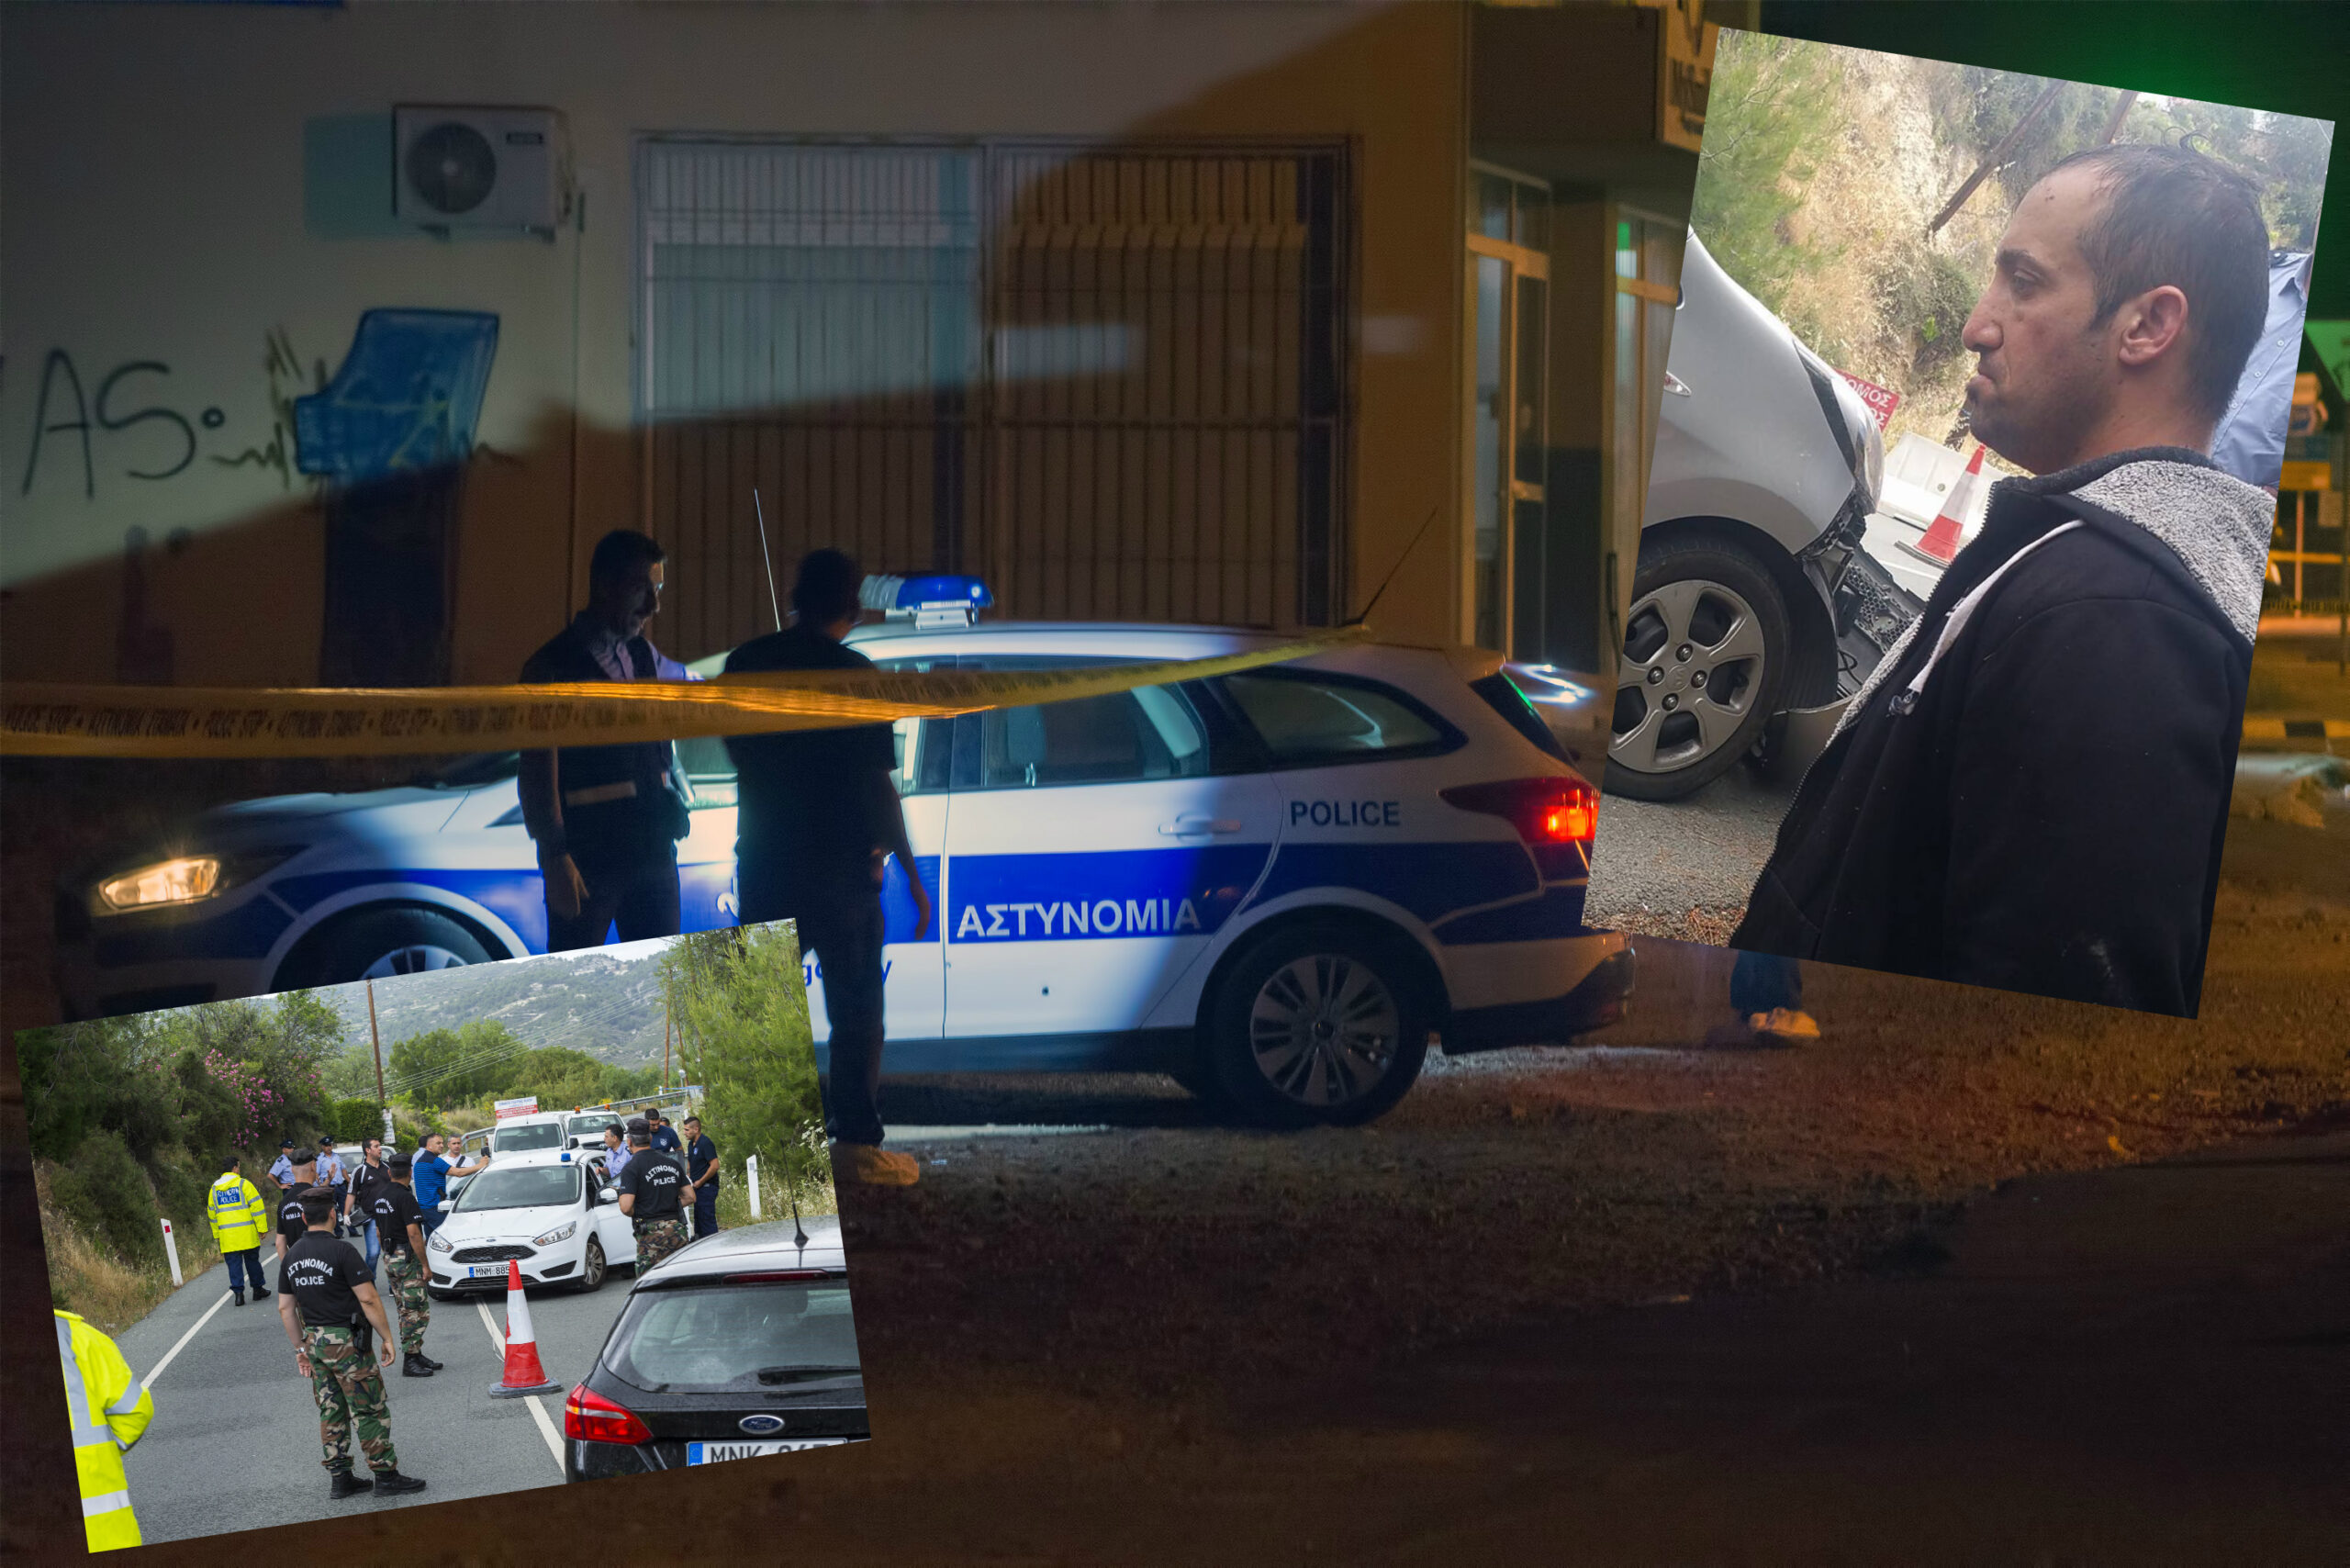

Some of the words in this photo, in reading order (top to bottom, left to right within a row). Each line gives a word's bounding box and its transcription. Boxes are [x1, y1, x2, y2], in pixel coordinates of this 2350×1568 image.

[1847, 379, 1893, 409] ΟΜΟΣ
[1290, 800, 1401, 826] POLICE
[957, 898, 1202, 938] ΑΣΤΥΝΟΜΙΑ
[653, 1176, 677, 1186] PLICE
[476, 1267, 492, 1276] MNM
